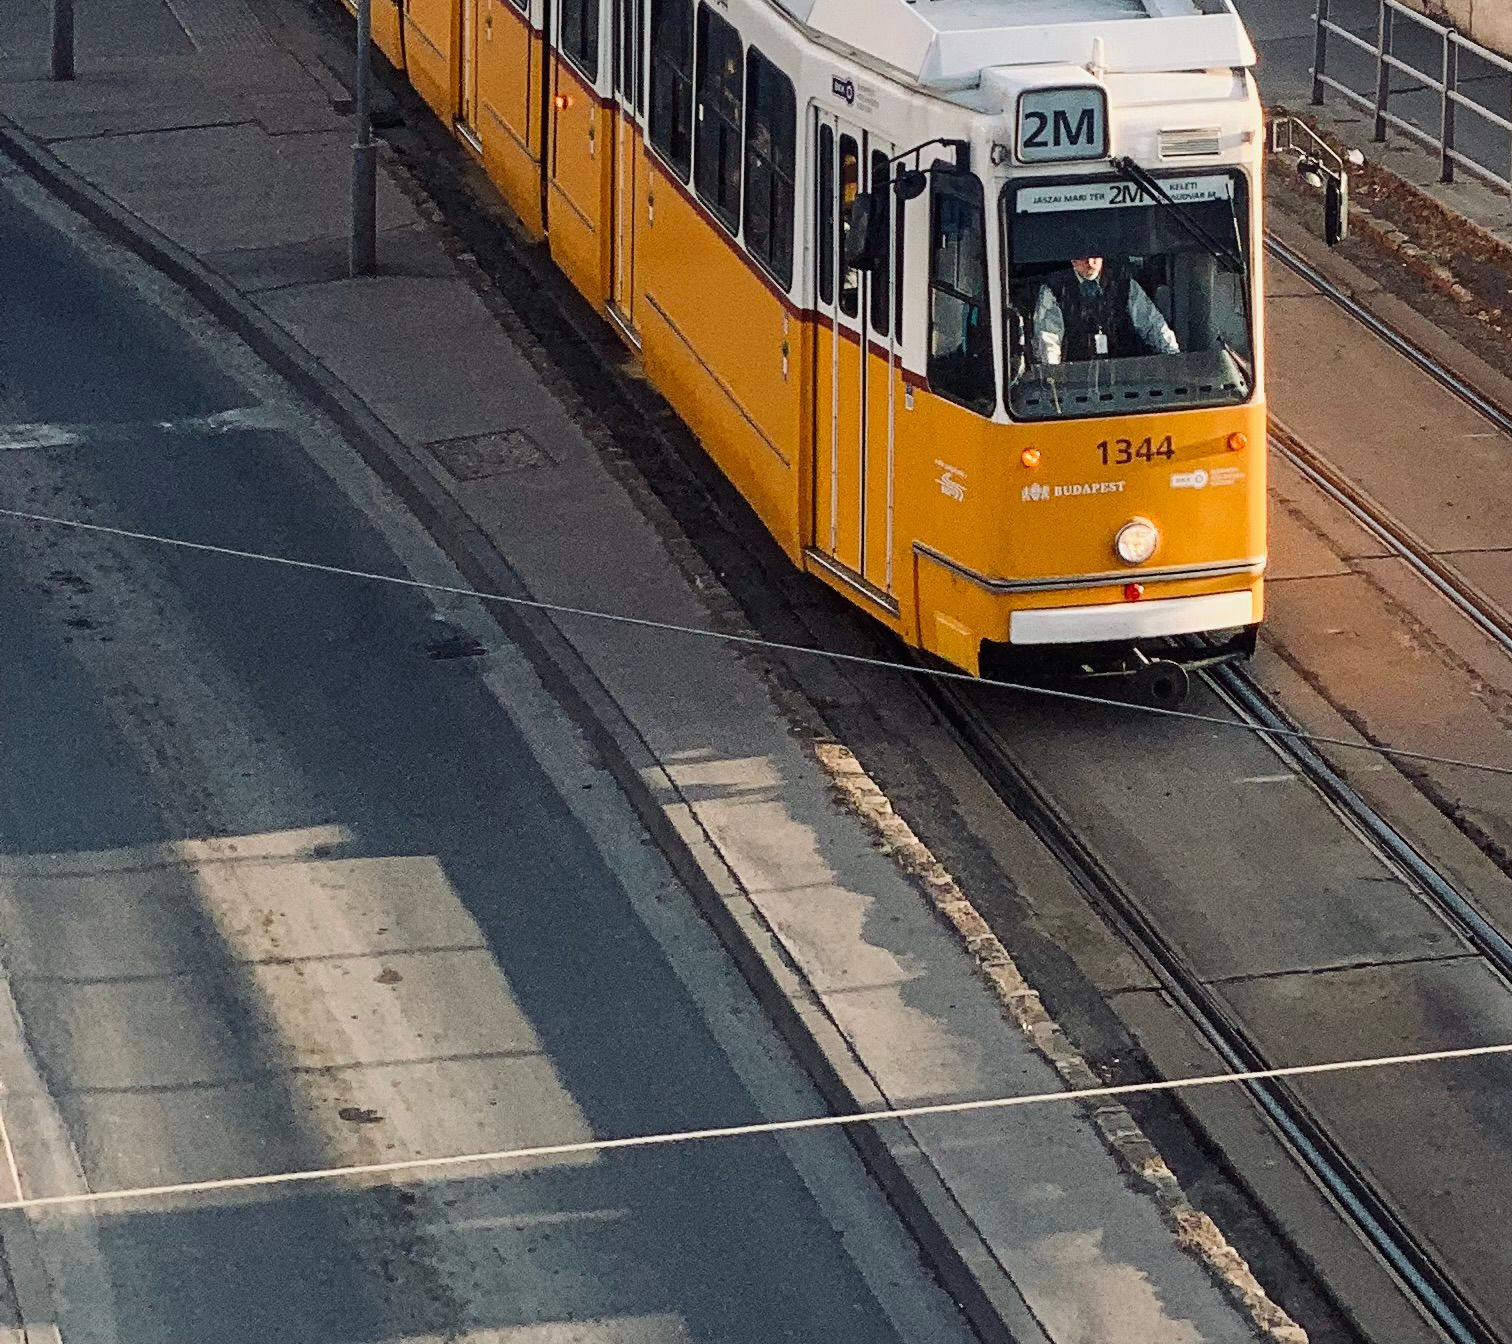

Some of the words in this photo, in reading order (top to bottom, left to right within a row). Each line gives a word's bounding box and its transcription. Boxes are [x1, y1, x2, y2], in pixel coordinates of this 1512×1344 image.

[1023, 108, 1095, 148] 2M
[1109, 184, 1145, 205] 2M
[1096, 434, 1176, 465] 1344
[1054, 480, 1126, 497] BUDAPEST
